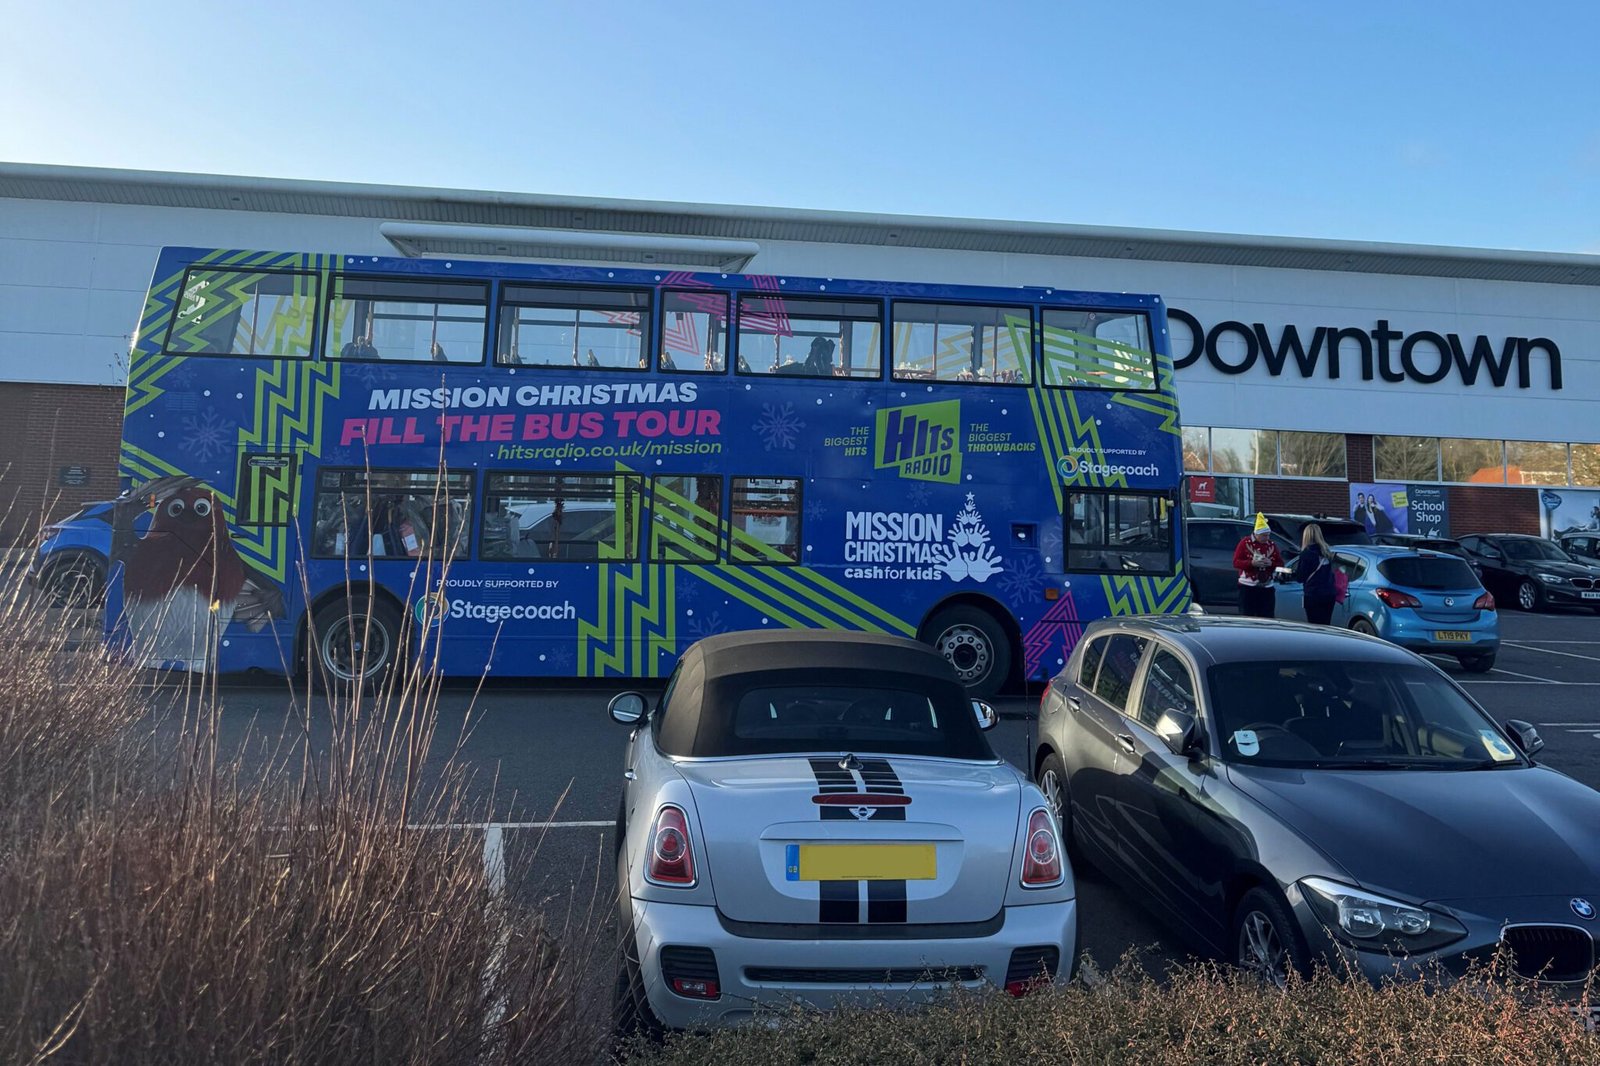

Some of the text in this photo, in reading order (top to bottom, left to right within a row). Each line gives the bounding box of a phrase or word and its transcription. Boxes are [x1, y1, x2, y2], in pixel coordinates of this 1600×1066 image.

[368, 382, 698, 410] MISSION CHRISTMAS
[340, 409, 721, 446] FILL THE BUS TOUR
[850, 426, 870, 435] THE
[970, 423, 989, 432] THE
[824, 436, 869, 446] BIGGEST
[968, 432, 1012, 442] BIGGEST
[497, 439, 722, 460] hitsradio.co.uk/mission
[844, 447, 867, 456] HITS
[967, 442, 1036, 453] THROWBACKS
[1099, 448, 1137, 456] SUPPORTED
[904, 453, 952, 476] RADIO
[1080, 460, 1160, 477] Stagecoach
[1411, 500, 1445, 511] School
[1416, 511, 1441, 524] Shop
[845, 511, 943, 542] MISSION
[844, 540, 943, 564] CHRISTMAS
[436, 579, 559, 588] PROUDLY SUPPORTED BY
[450, 599, 576, 623] Stagecoach
